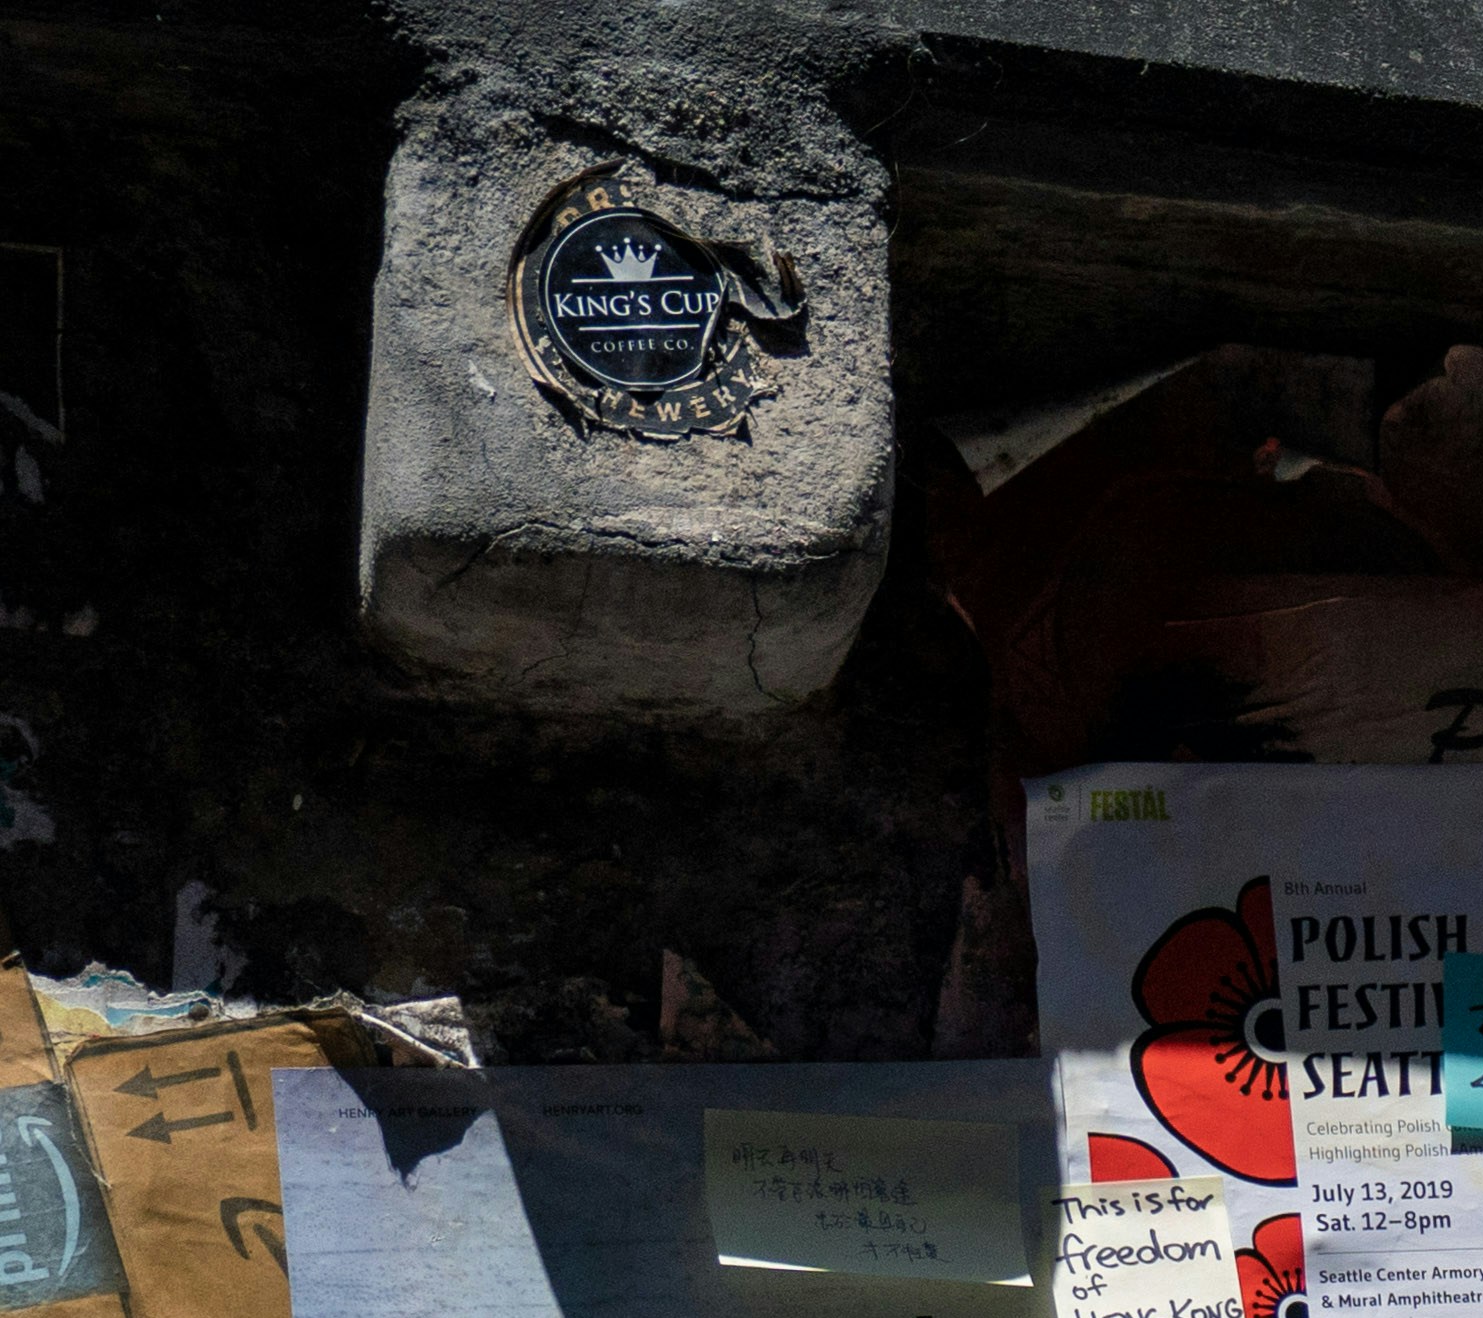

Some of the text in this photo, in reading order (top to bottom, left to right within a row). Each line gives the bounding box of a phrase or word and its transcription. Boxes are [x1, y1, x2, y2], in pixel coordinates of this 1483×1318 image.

[553, 290, 721, 318] KING'S CUP
[590, 338, 695, 353] COFFEE CO.
[1290, 914, 1470, 963] POLISH
[1053, 1190, 1214, 1222] This is for
[1311, 1181, 1454, 1207] July 13, 2019
[1316, 1211, 1356, 1233] Sat.
[1055, 1233, 1221, 1272] freedom
[1318, 1268, 1369, 1284] Seattle
[1374, 1266, 1423, 1283] Center
[1073, 1276, 1106, 1301] of
